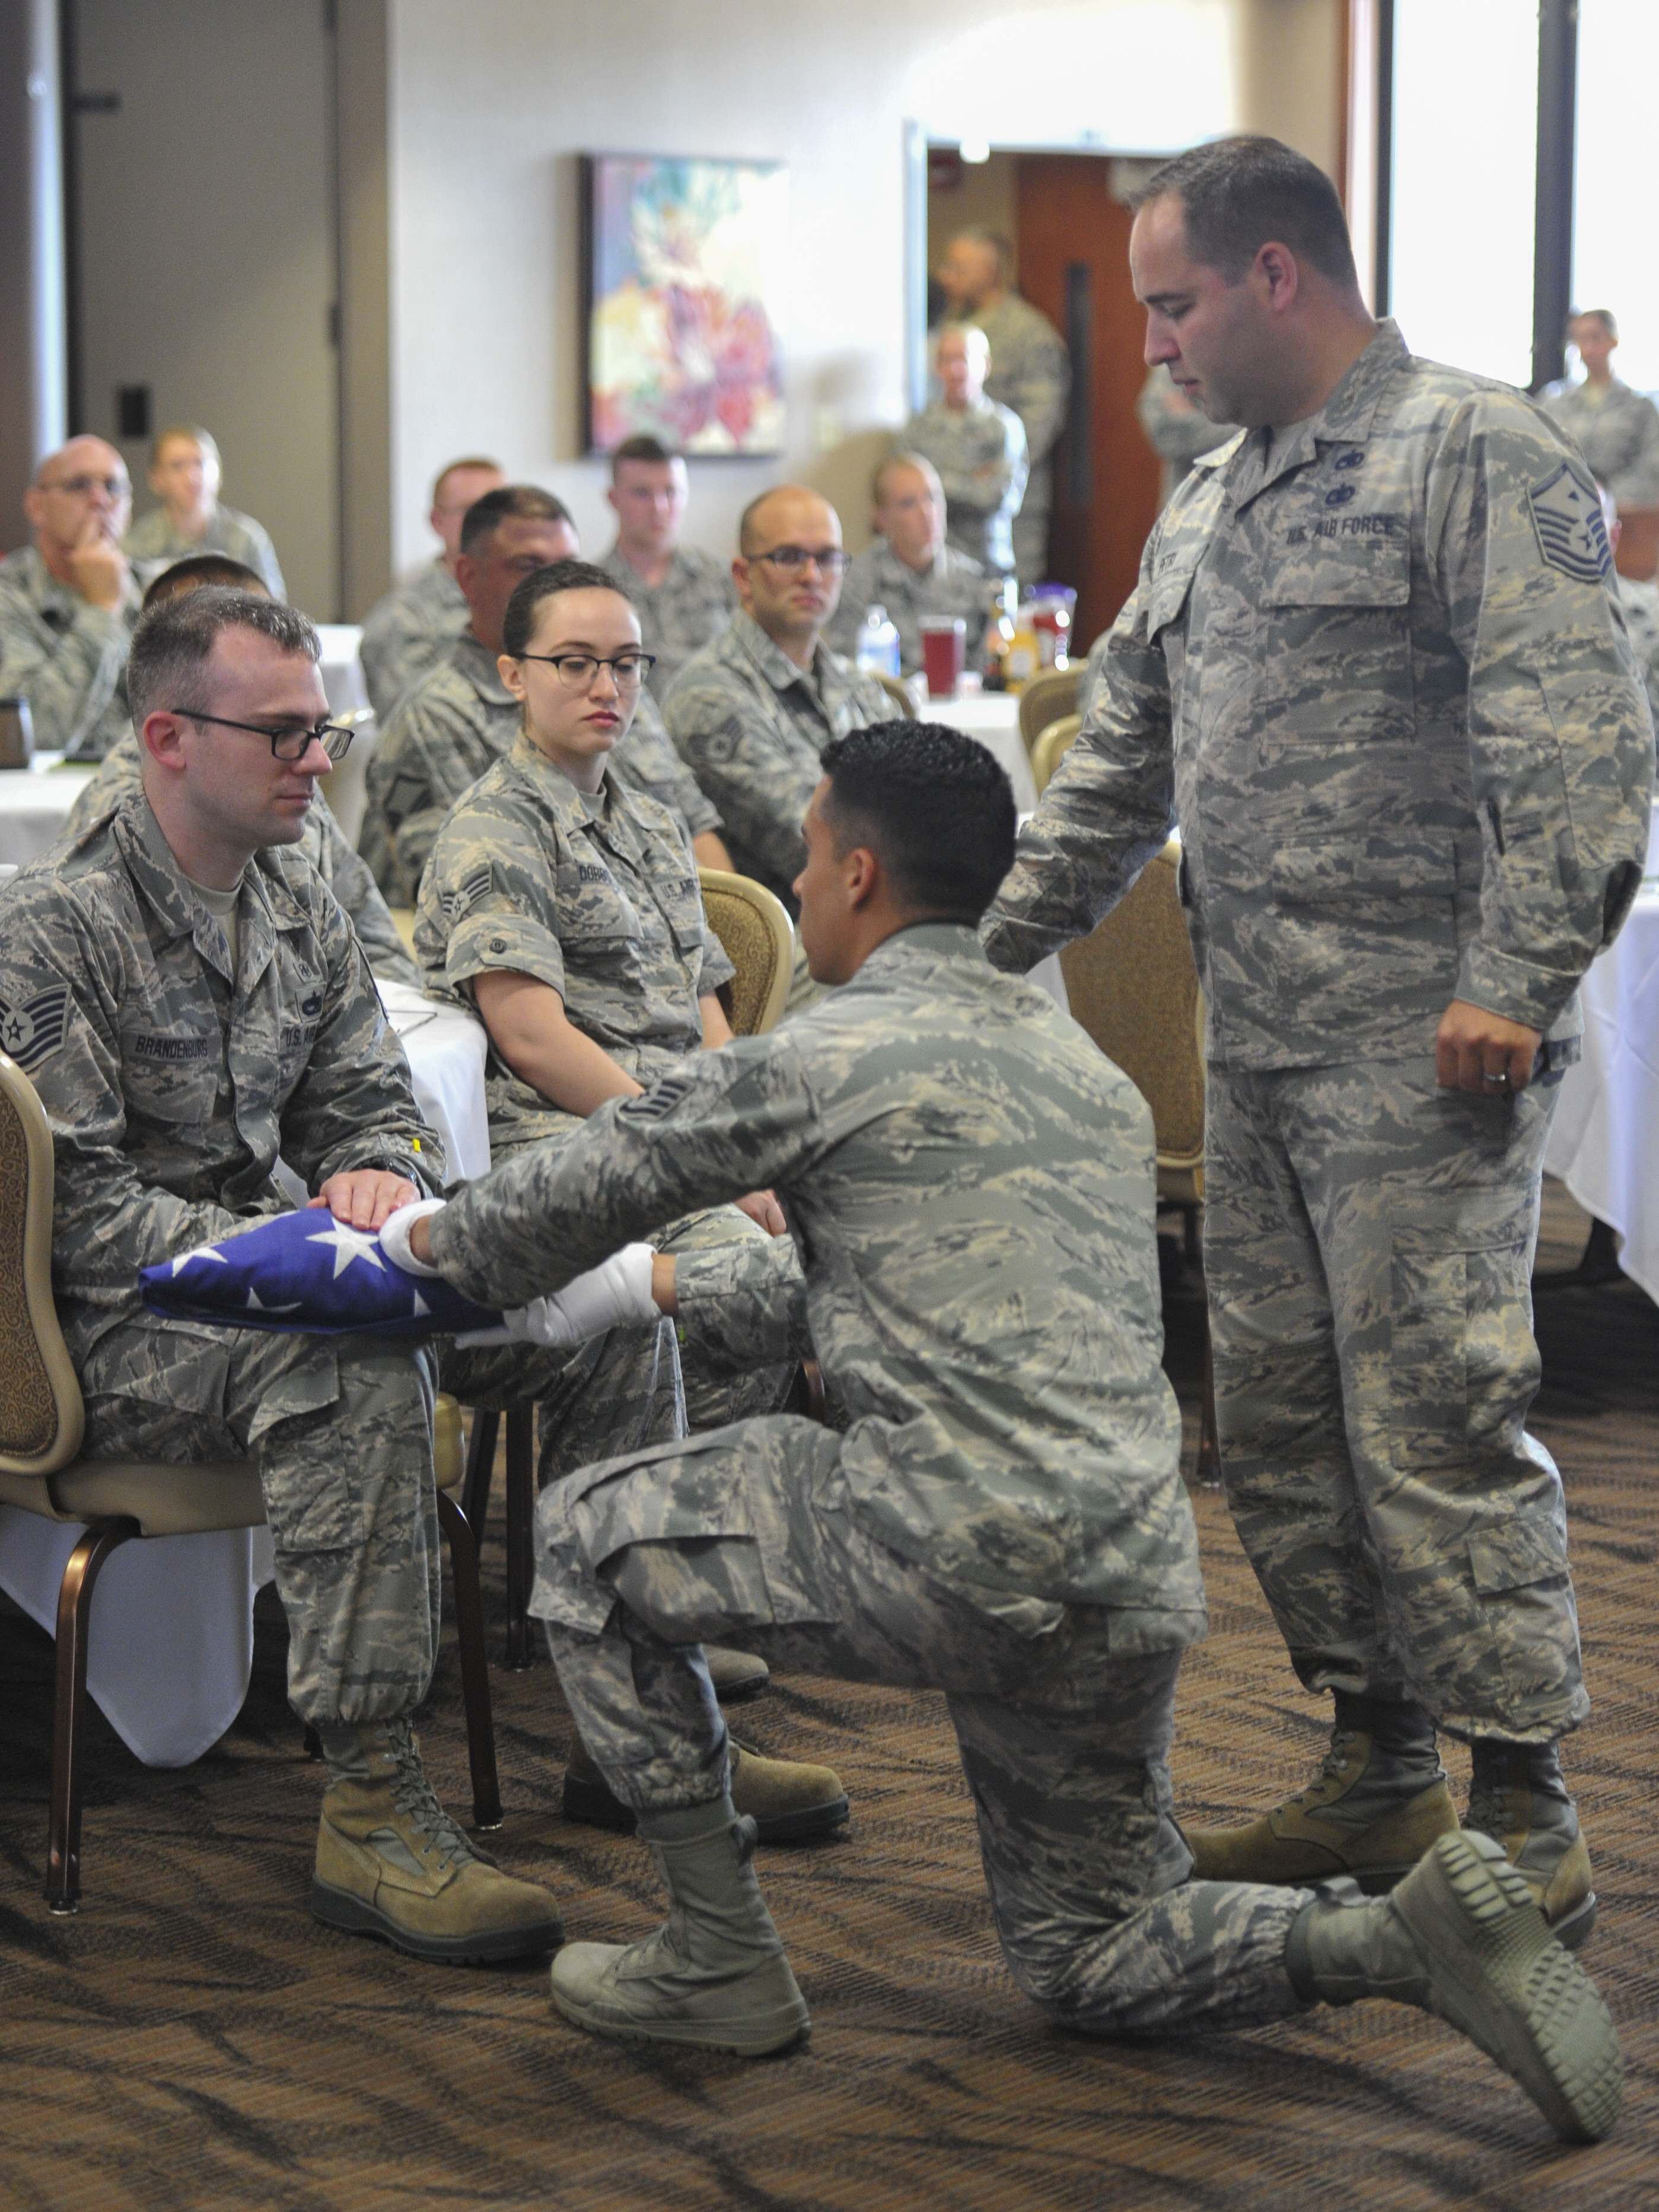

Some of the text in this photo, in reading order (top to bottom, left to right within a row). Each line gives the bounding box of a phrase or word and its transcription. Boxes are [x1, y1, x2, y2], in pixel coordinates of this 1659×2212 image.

[1313, 517, 1339, 538] AIR
[1341, 513, 1396, 535] FORCE
[135, 1035, 208, 1058] BRANDENBURG
